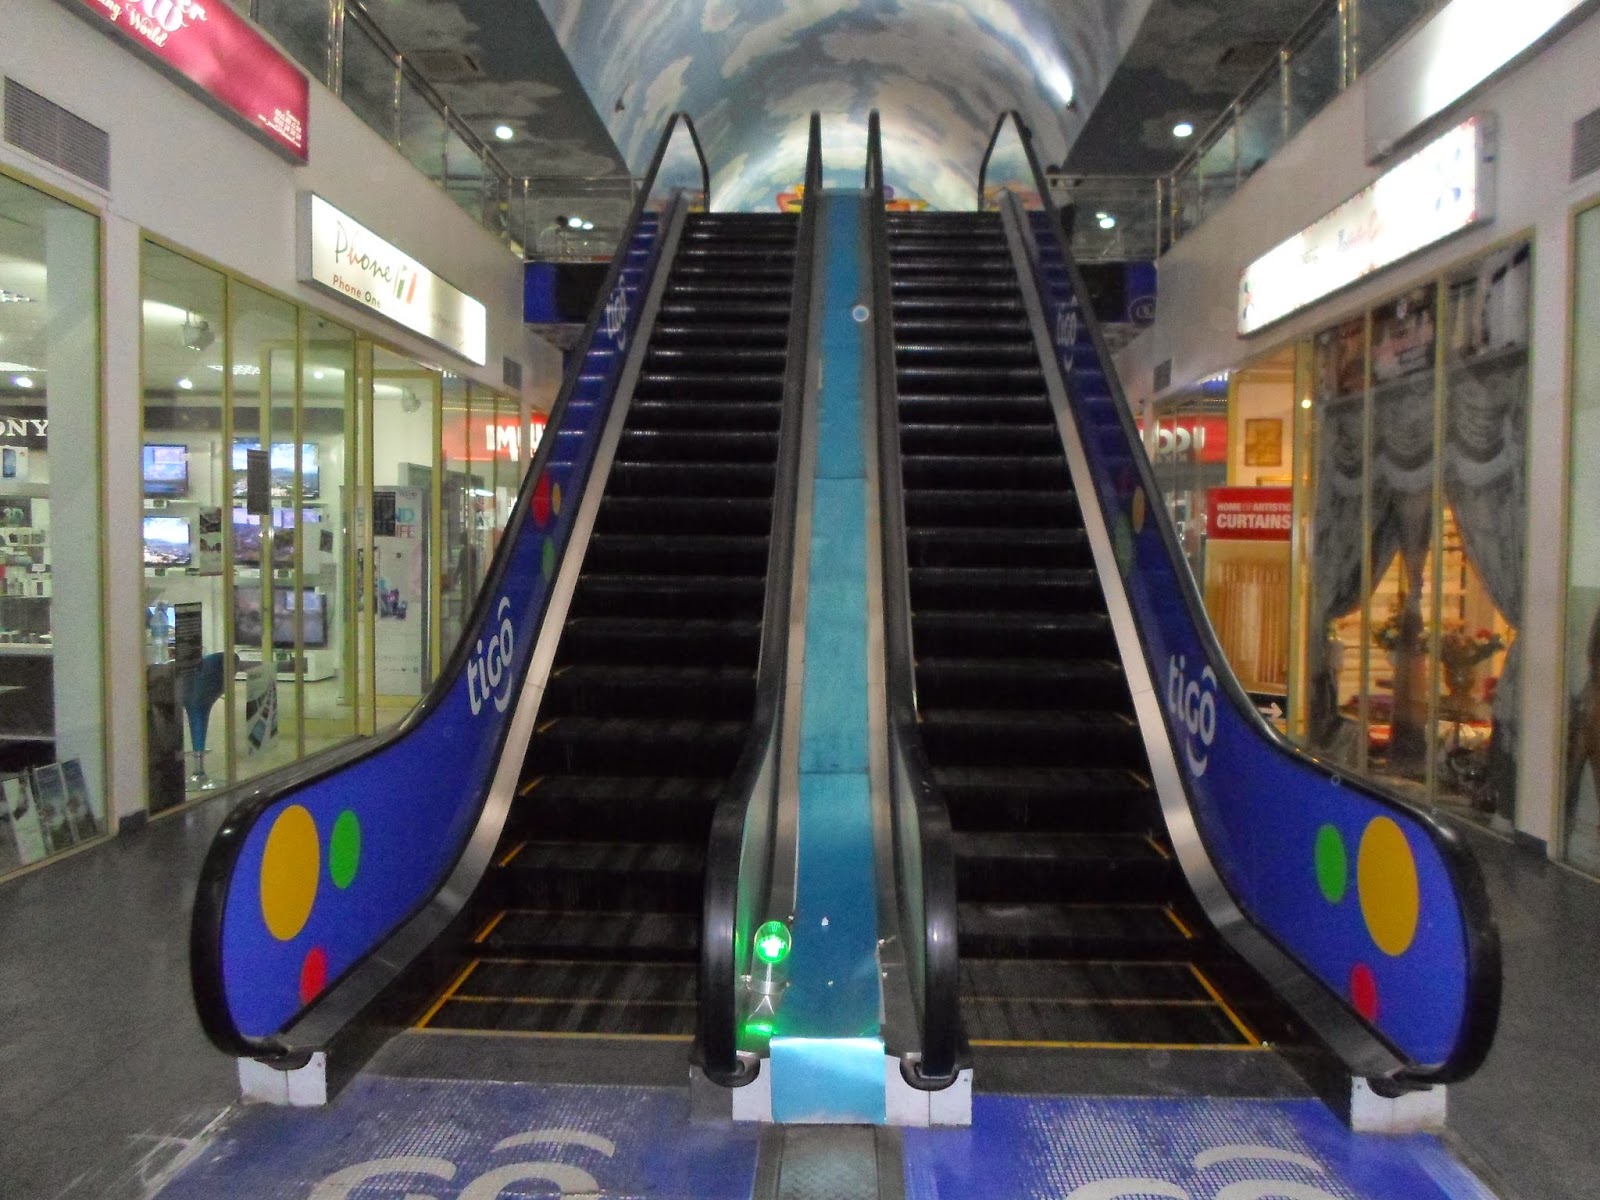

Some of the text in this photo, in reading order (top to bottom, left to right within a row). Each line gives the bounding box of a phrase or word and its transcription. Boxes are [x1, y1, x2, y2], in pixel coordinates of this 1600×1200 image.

[126, 3, 169, 48] World
[333, 273, 382, 309] Phone One
[1216, 502, 1242, 512] HOME
[1252, 502, 1291, 512] ARTISTIC
[1216, 513, 1291, 529] CURTAINS
